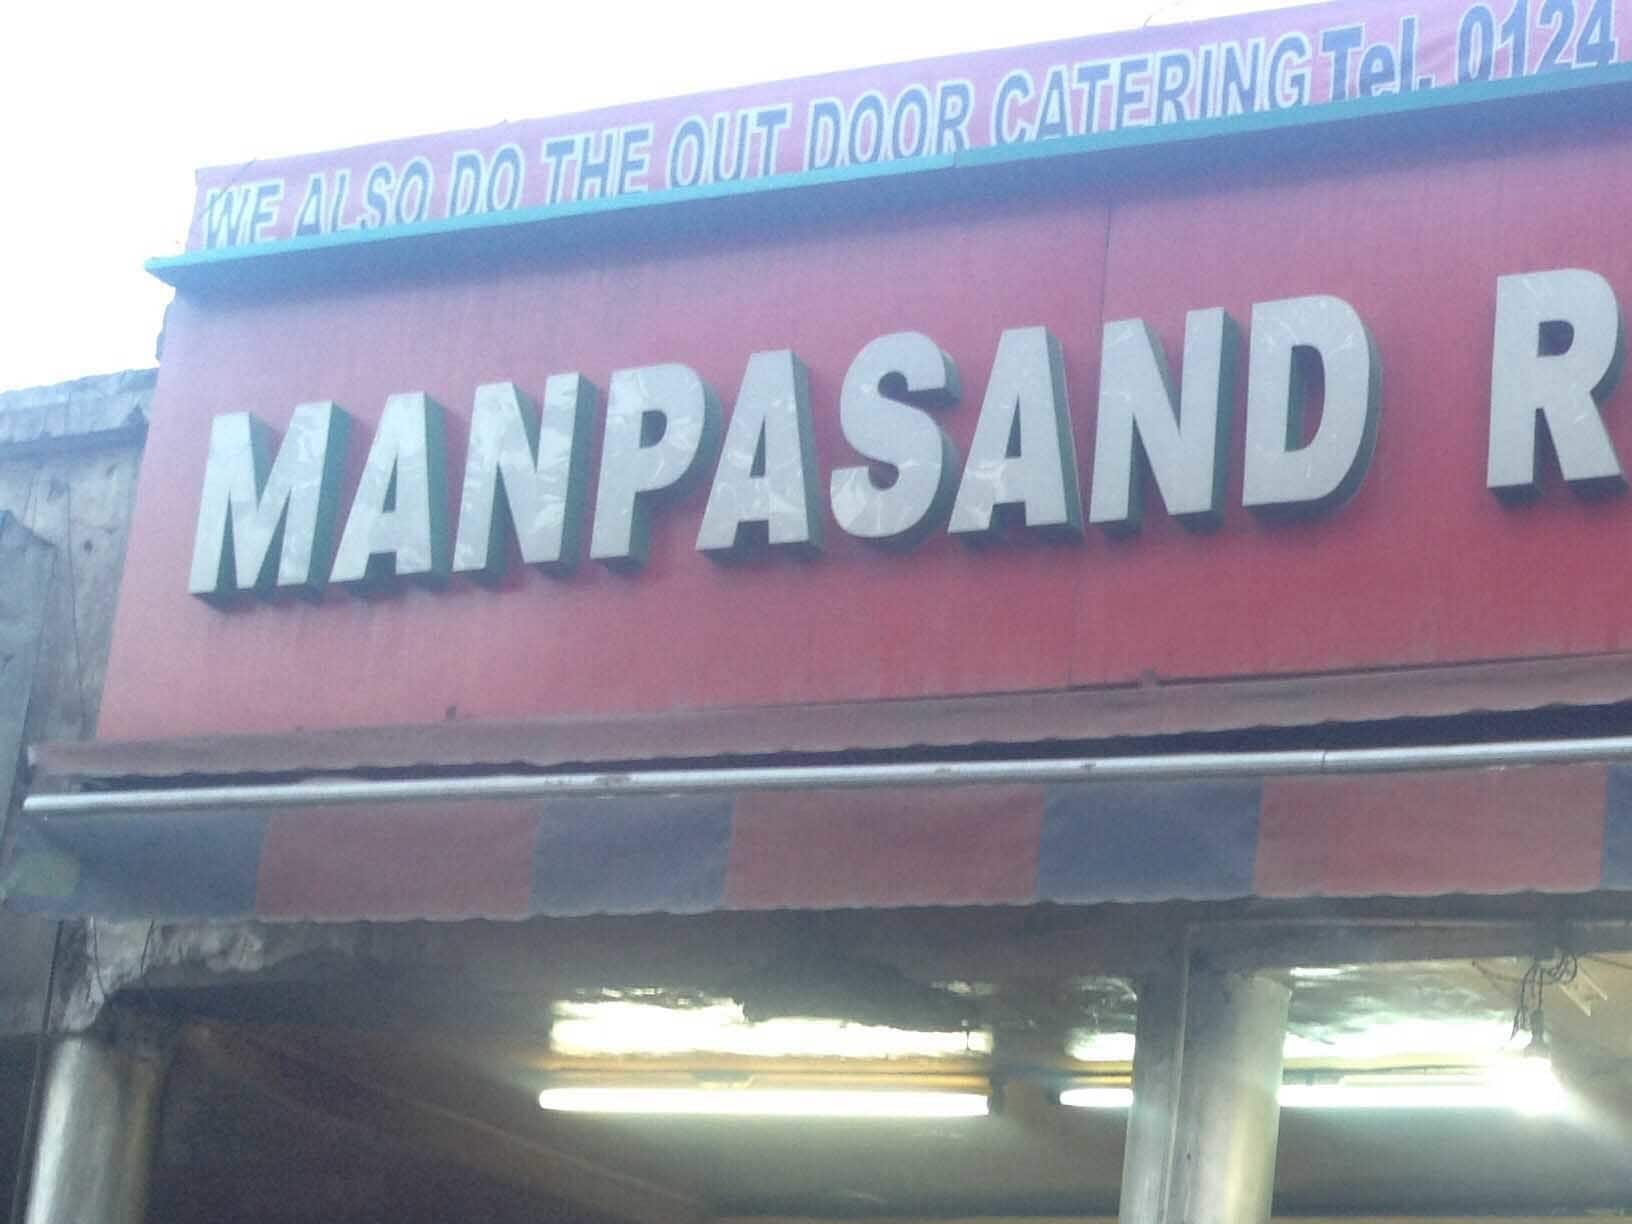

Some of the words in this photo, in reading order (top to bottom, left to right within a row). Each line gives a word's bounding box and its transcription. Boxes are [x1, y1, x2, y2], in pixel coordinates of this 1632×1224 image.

[201, 181, 281, 250] WE
[294, 157, 434, 239] ALSO
[447, 144, 525, 219] DO
[542, 122, 655, 201] THE
[666, 106, 793, 189] OUT
[809, 79, 975, 172] DOOR
[990, 32, 1312, 147] CATERING
[1455, 0, 1620, 90] 0124
[187, 294, 1384, 606] MANPASAND
